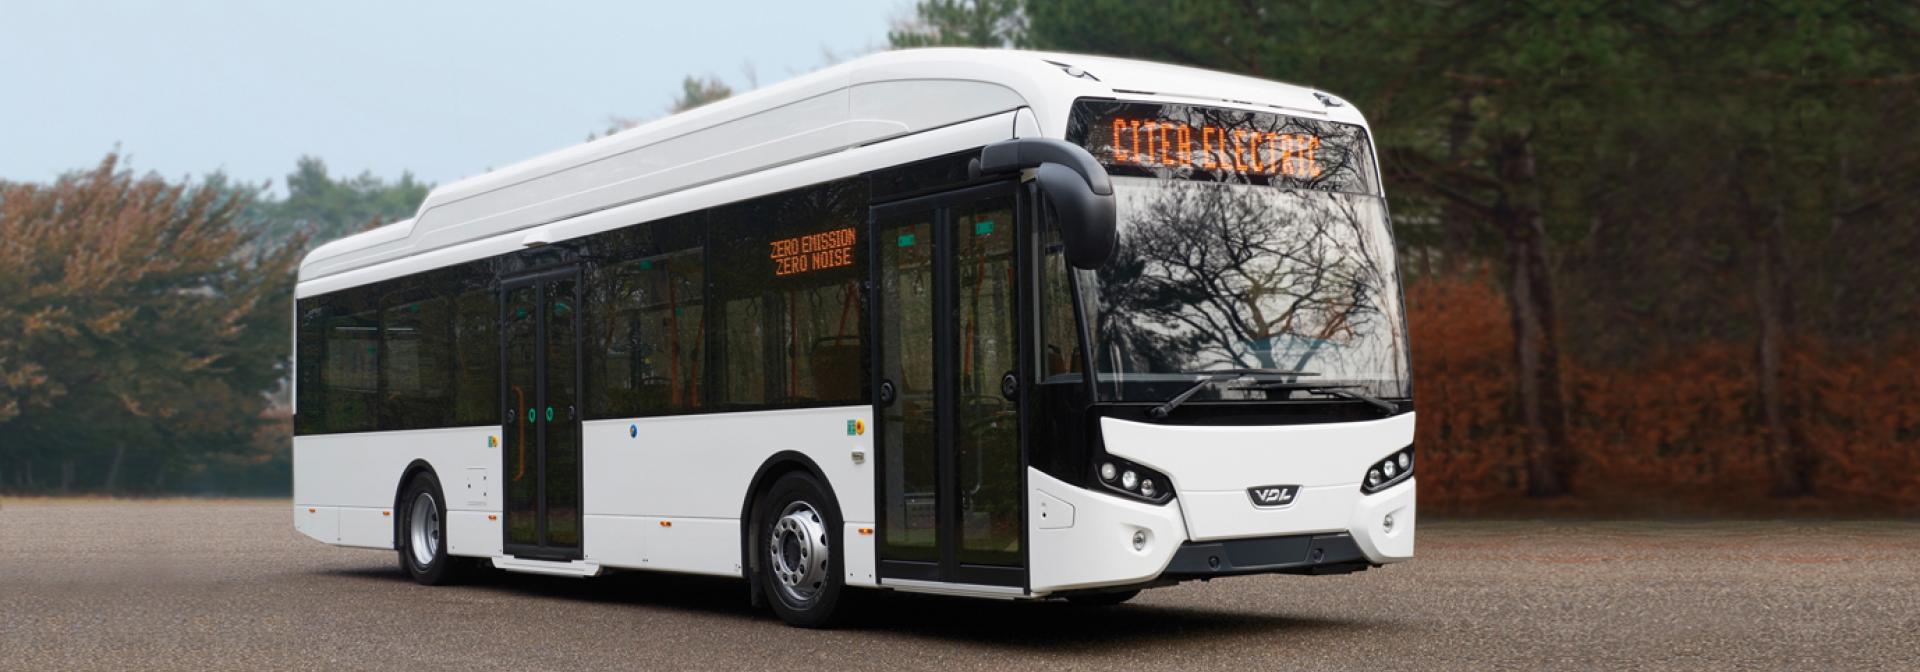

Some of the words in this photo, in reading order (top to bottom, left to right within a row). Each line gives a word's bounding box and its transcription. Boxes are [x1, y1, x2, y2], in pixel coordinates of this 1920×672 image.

[1112, 118, 1192, 166] CITEA
[1202, 126, 1321, 177] ELECTRIC
[769, 237, 799, 258] ZERO
[801, 227, 856, 252] EMISSION
[776, 255, 808, 275] ZERO
[812, 247, 853, 270] NOISE
[1255, 488, 1291, 502] VDL
